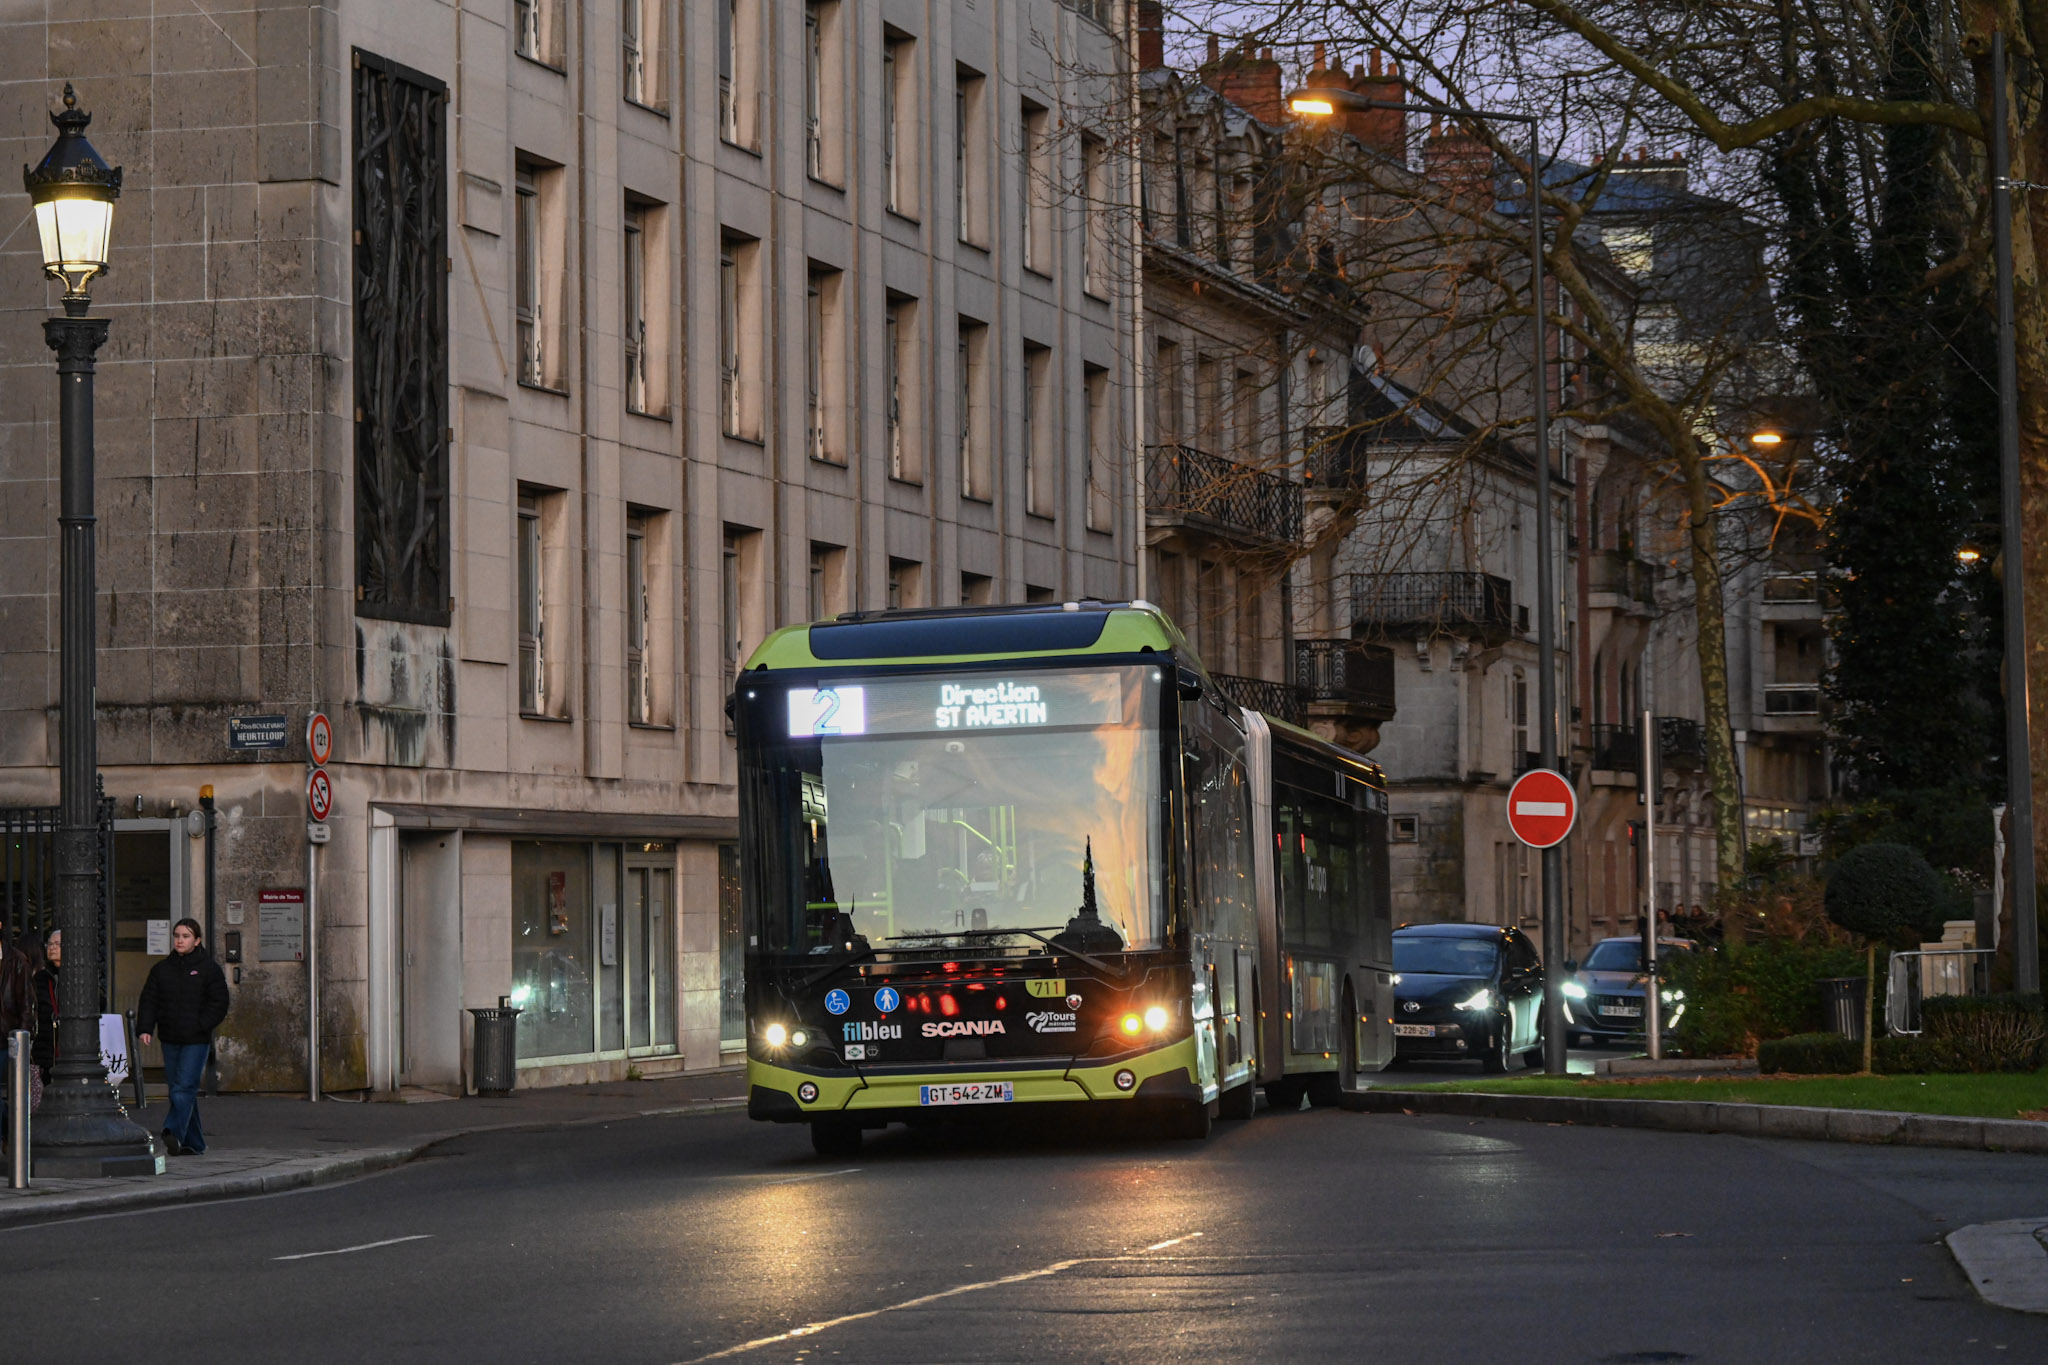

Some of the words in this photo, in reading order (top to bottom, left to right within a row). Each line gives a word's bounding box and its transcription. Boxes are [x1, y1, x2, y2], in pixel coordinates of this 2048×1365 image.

[941, 682, 1040, 707] Direction
[813, 689, 841, 734] 2
[935, 705, 960, 728] ST
[965, 701, 1047, 727] AVERTIN
[237, 731, 285, 741] HEURTELOUP
[1035, 981, 1059, 996] 711
[1047, 1012, 1076, 1021] Tours
[842, 1021, 902, 1041] filbleu
[921, 1020, 1006, 1038] SCANIA
[929, 1084, 1003, 1102] GT-542-ZM
